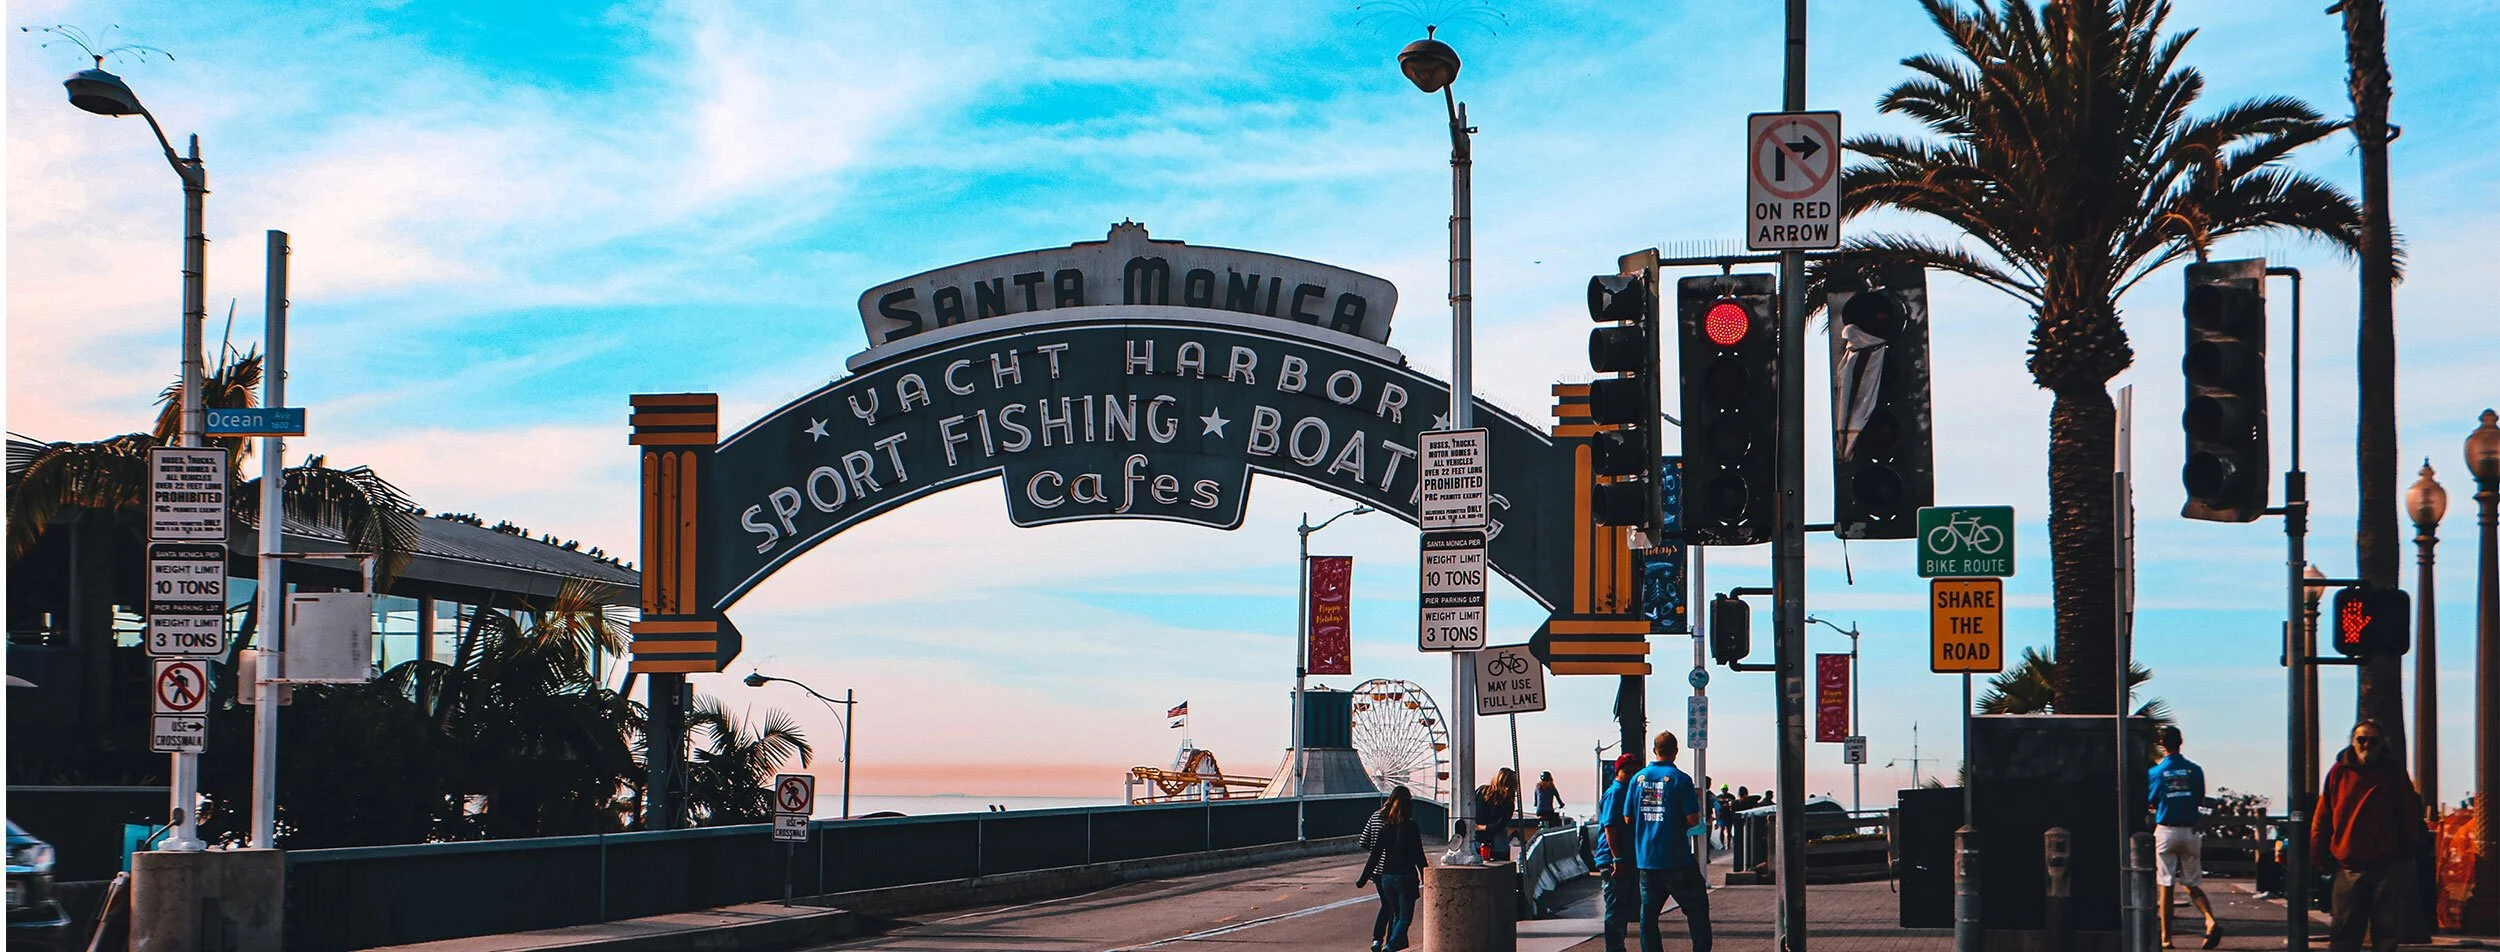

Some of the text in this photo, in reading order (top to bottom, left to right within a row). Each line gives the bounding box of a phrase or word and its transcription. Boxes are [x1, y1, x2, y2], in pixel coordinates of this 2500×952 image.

[1756, 202, 1830, 220] ON RED
[1758, 224, 1829, 242] ARROW
[878, 256, 1367, 343] SANTA MONICA
[848, 340, 1409, 427] YACHT HARBOR
[207, 412, 262, 427] Ocean
[1430, 439, 1477, 449] BUSES, TRUCKS,
[1428, 450, 1448, 458] MOTOR
[1450, 449, 1471, 457] HOMES
[1446, 458, 1473, 466] VEHICLES
[741, 432, 909, 555] SPORT
[939, 395, 1179, 467] FISHING
[1468, 466, 1482, 474] LONG
[1424, 476, 1482, 490] PROHIBITED
[155, 492, 222, 503] PROHIBITED
[1467, 504, 1482, 512] ONLY
[1426, 554, 1480, 564] WEIGHT LIMIT
[154, 566, 220, 574] WEIGHT LIMIT
[1926, 560, 2005, 572] BIKE ROUTE
[1426, 570, 1480, 586] 10 TONS
[155, 580, 220, 594] 10 TONS
[1938, 591, 1995, 608] SHARE
[1319, 604, 1340, 614] Happy
[1425, 612, 1480, 621] WEIGHT LIMIT
[154, 619, 219, 627] WEIGHT LIMIT
[1950, 617, 1984, 634] THE
[156, 633, 217, 647] 3 TONS
[1426, 626, 1478, 642] 3 TONS
[1944, 643, 1990, 660] ROAD
[1488, 678, 1531, 692] MAY USE
[1484, 693, 1538, 708] FULL LANE
[172, 722, 188, 732] USE
[156, 736, 202, 746] CROSSWALK
[1852, 750, 1860, 761] 5
[1644, 812, 1664, 822] TOURS
[776, 828, 806, 836] CROSSWALK
